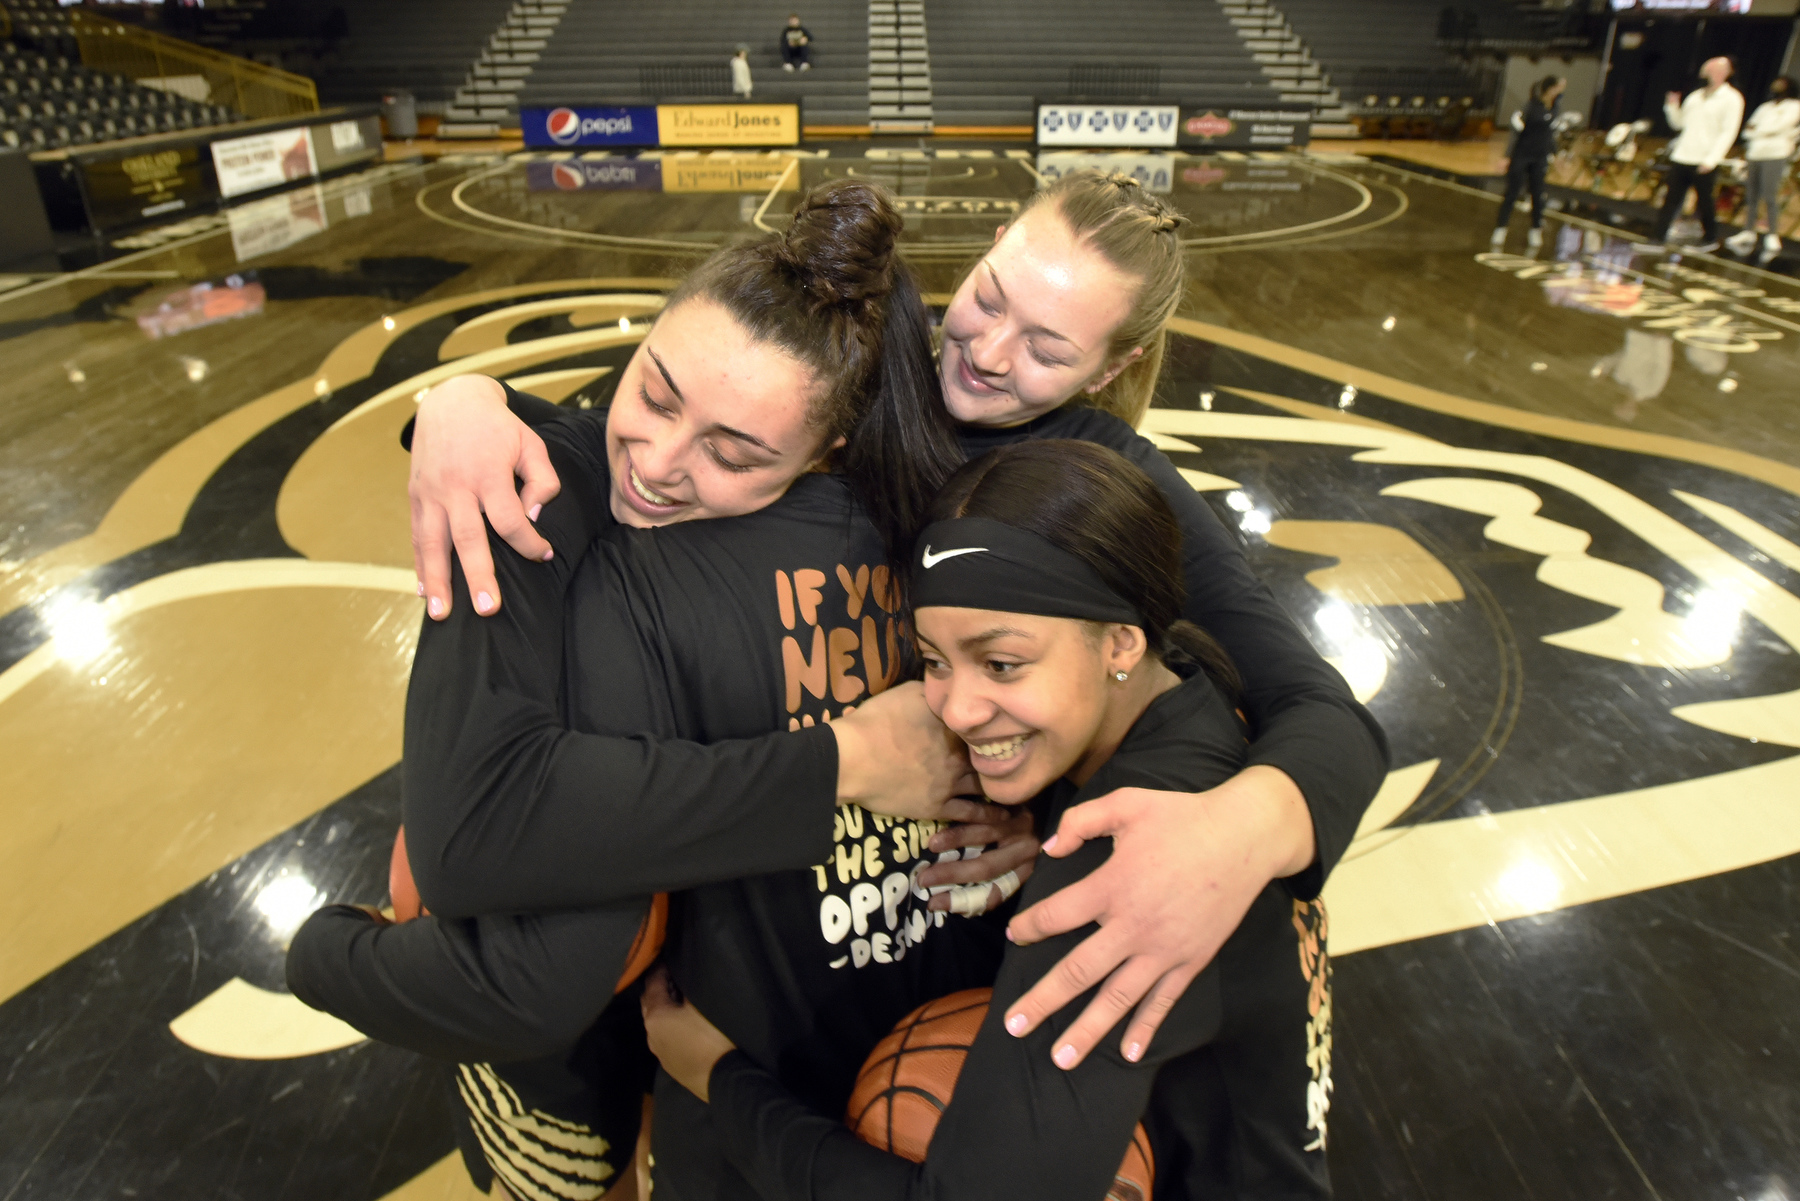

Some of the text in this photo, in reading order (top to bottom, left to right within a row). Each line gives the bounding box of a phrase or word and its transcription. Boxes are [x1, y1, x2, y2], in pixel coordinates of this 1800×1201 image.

[582, 114, 633, 136] pepsi
[674, 110, 781, 128] Edward Jones
[775, 563, 903, 630] IF YO
[811, 821, 947, 893] THE SID
